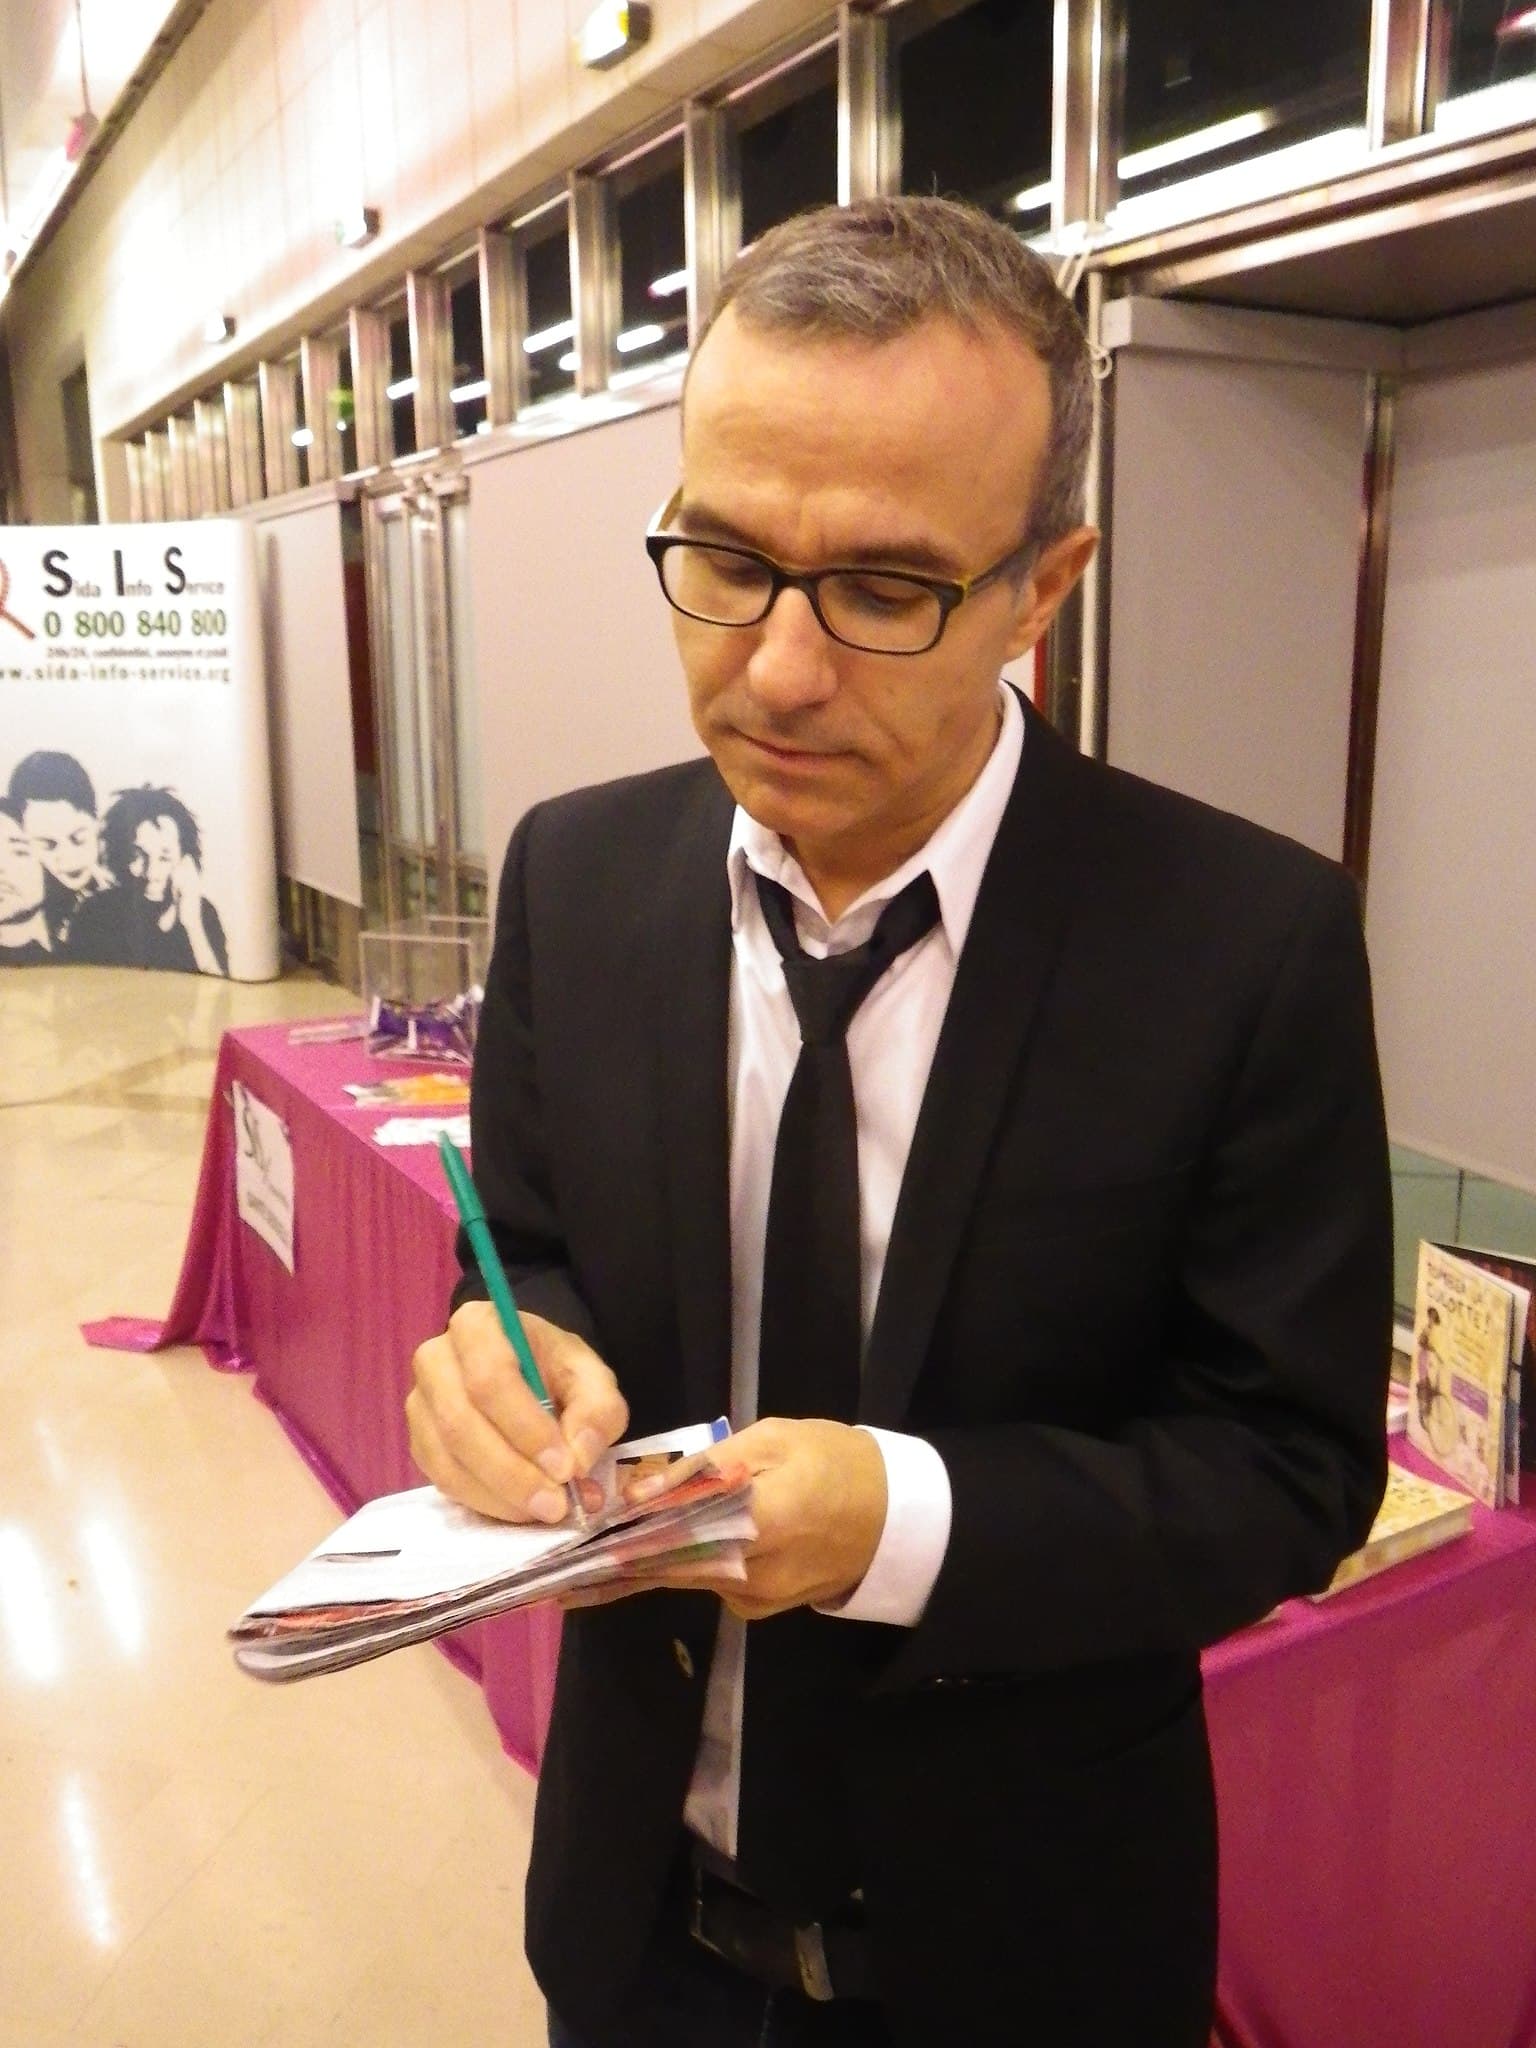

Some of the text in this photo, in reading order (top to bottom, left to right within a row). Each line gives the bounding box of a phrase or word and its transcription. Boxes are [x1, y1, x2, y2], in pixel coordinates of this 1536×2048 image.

[42, 545, 224, 598] Sida Info Service
[44, 607, 227, 638] 0 800 840 800
